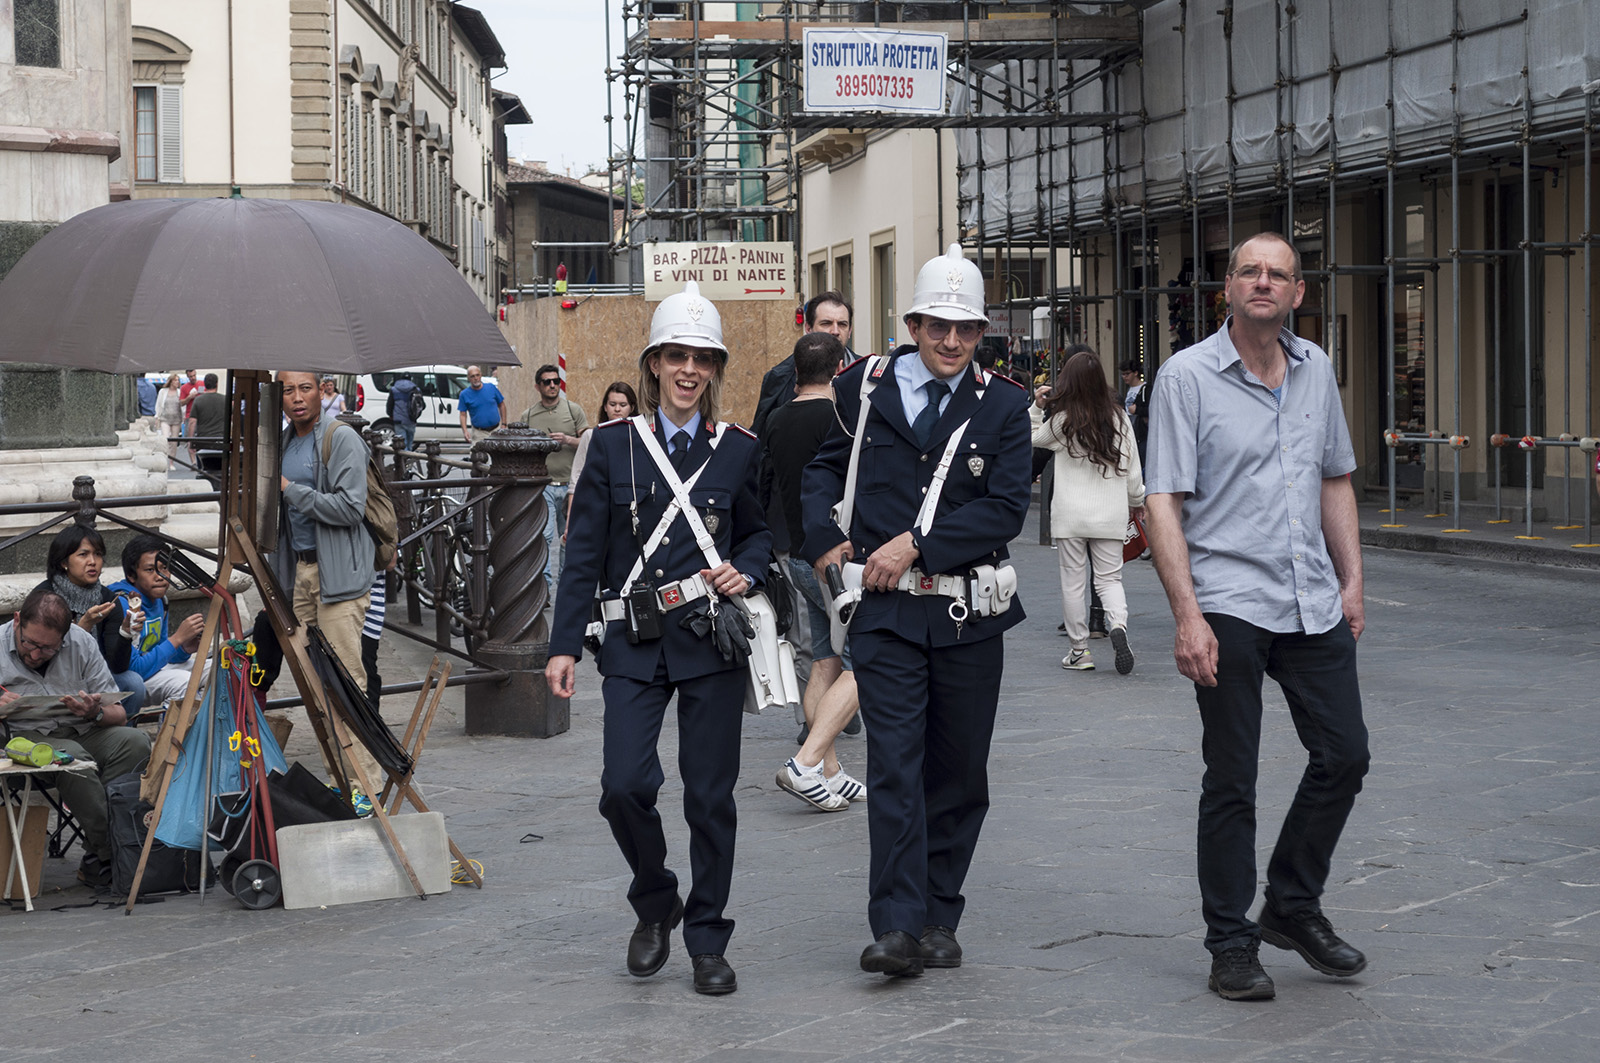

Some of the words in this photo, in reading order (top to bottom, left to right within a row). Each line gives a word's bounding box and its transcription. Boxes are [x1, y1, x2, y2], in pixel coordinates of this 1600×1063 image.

[812, 42, 878, 67] STRUTTURA
[882, 43, 938, 70] PROTETTA
[836, 74, 914, 99] 3895037335
[653, 252, 678, 265] BAR
[691, 246, 728, 265] PIZZA
[740, 248, 784, 264] PANINI
[654, 270, 662, 282] E
[672, 269, 704, 282] VINI
[713, 269, 728, 281] DI
[737, 269, 786, 281] NANTE
